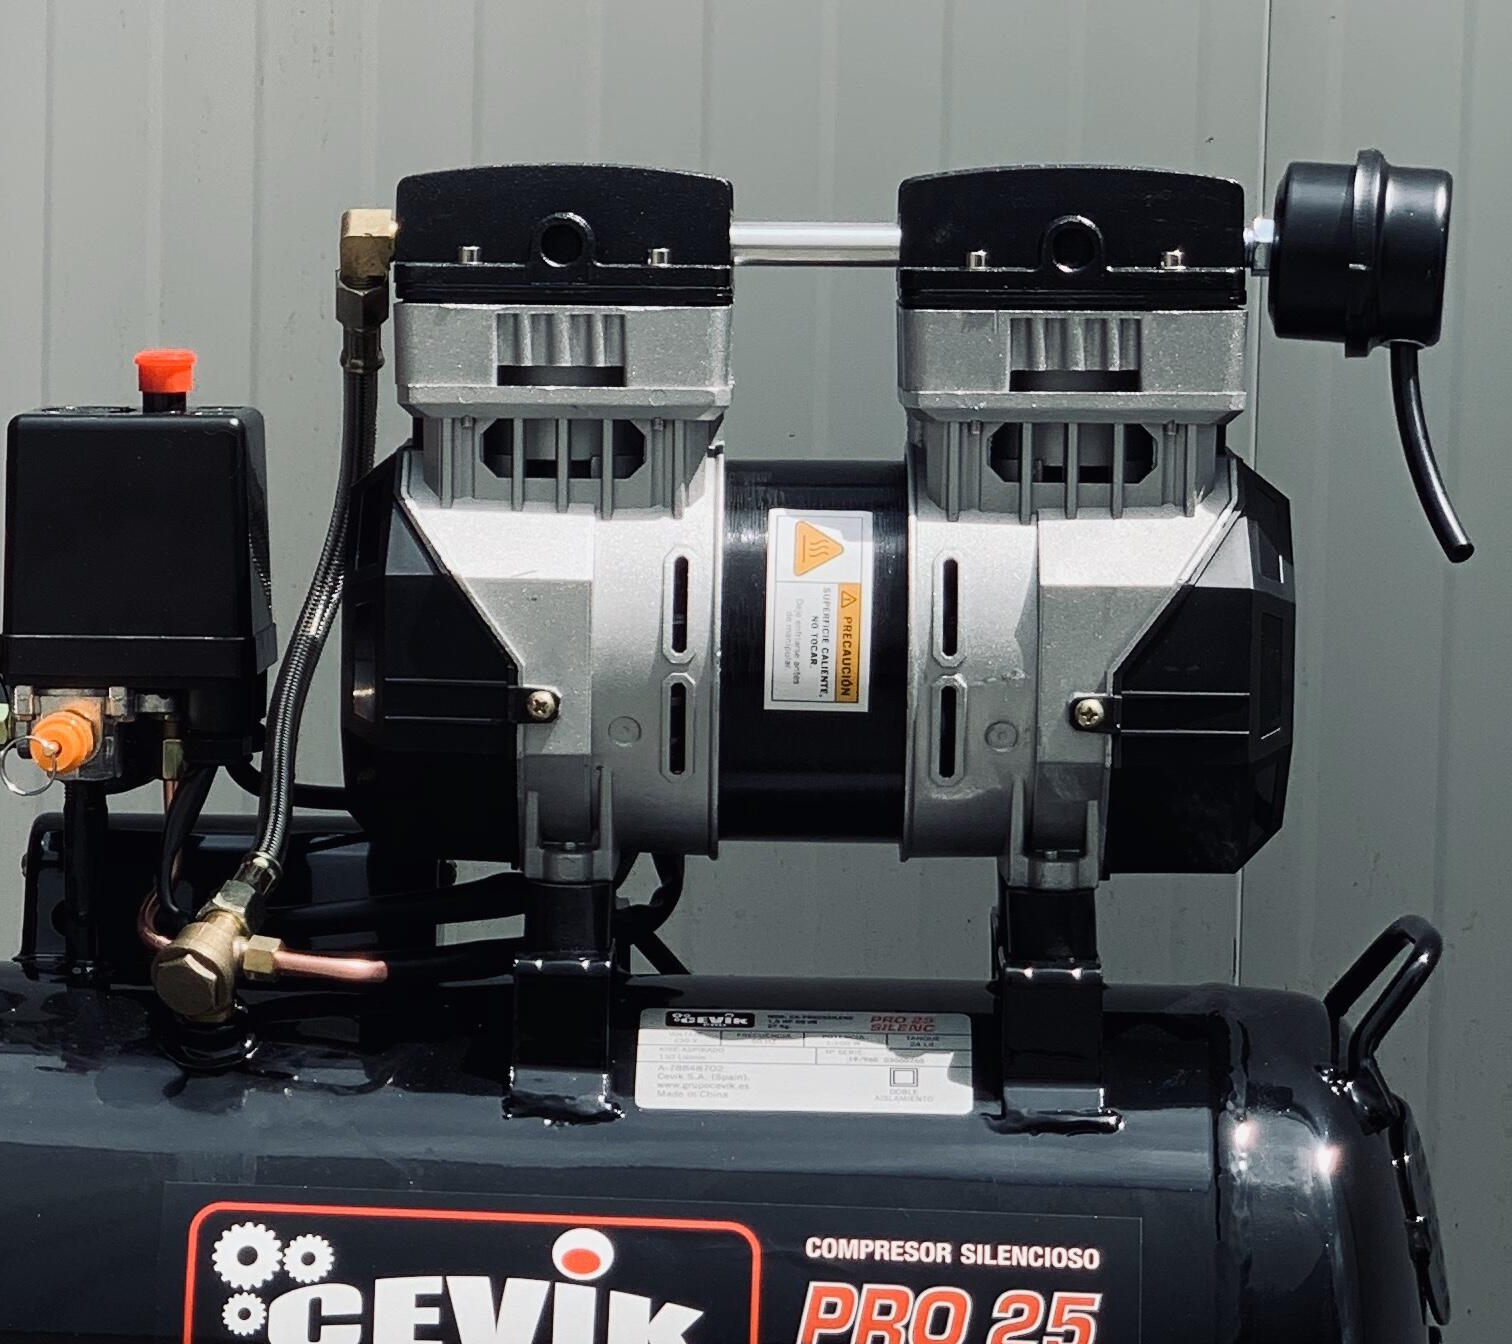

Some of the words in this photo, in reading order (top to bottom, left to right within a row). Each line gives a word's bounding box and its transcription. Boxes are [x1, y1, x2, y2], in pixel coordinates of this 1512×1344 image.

[811, 615, 819, 629] NO
[821, 587, 831, 644] SUPERFICIE
[841, 616, 853, 697] PRECAUCIÓN
[804, 1236, 953, 1263] COMPRESOR
[960, 1243, 1101, 1269] SILENCIOSO
